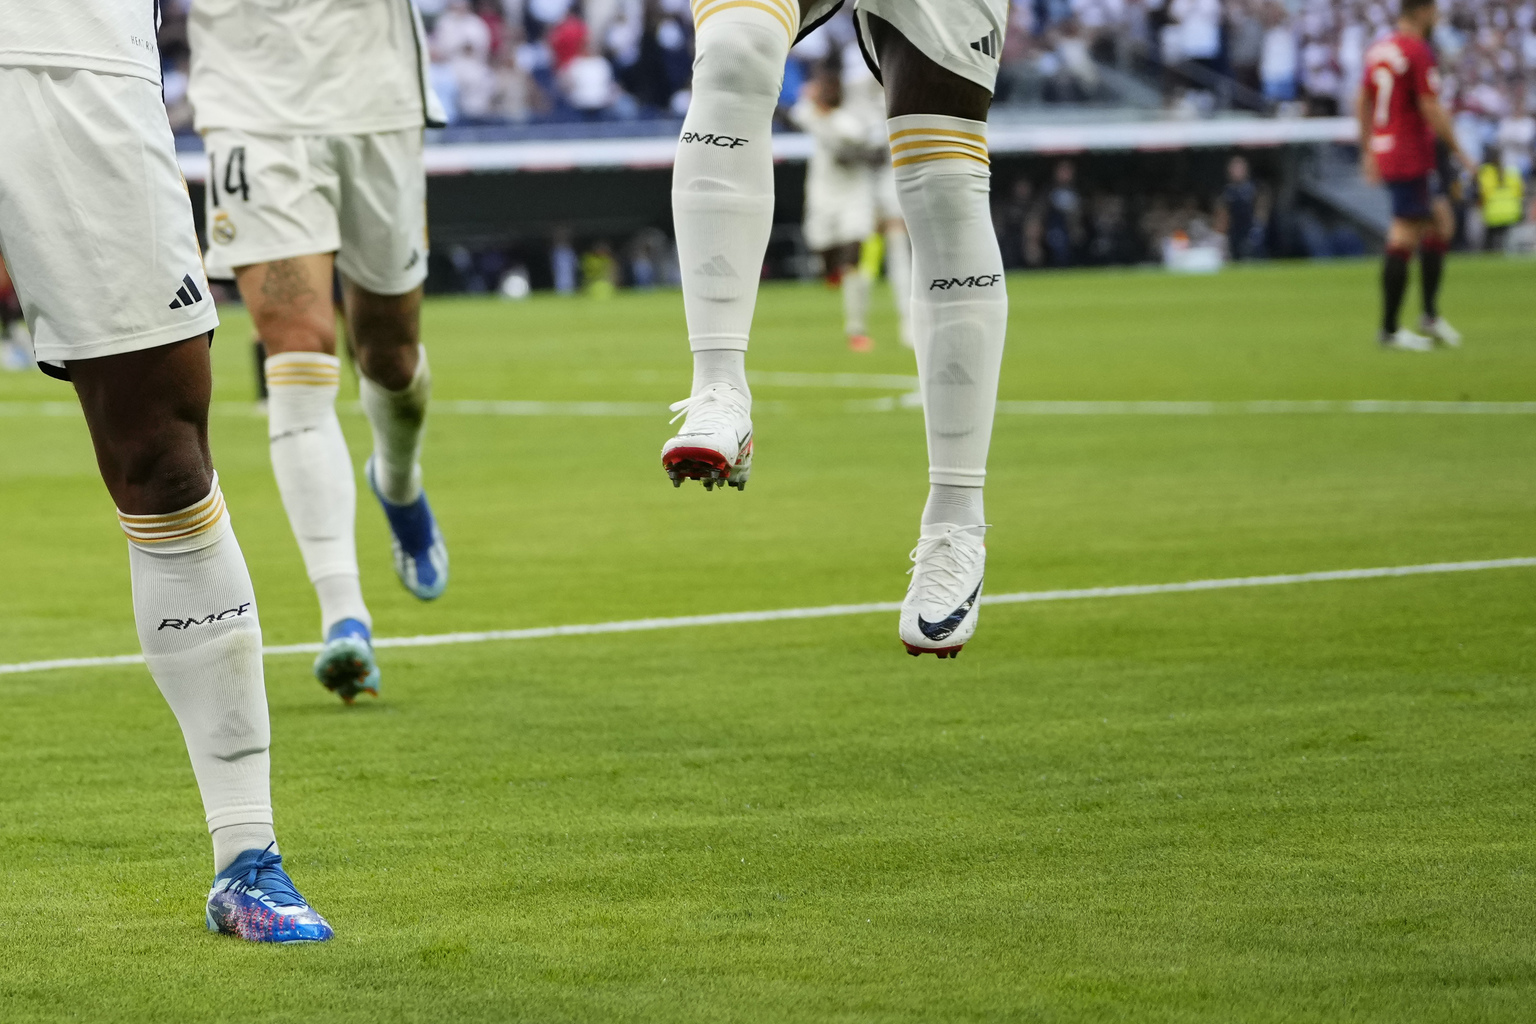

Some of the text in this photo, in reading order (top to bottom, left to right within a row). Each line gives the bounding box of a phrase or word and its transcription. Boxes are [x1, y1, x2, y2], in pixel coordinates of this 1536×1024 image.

[680, 132, 749, 149] RMCF
[210, 146, 250, 207] 14
[929, 274, 1002, 291] RMCF
[156, 603, 251, 631] RMCF
